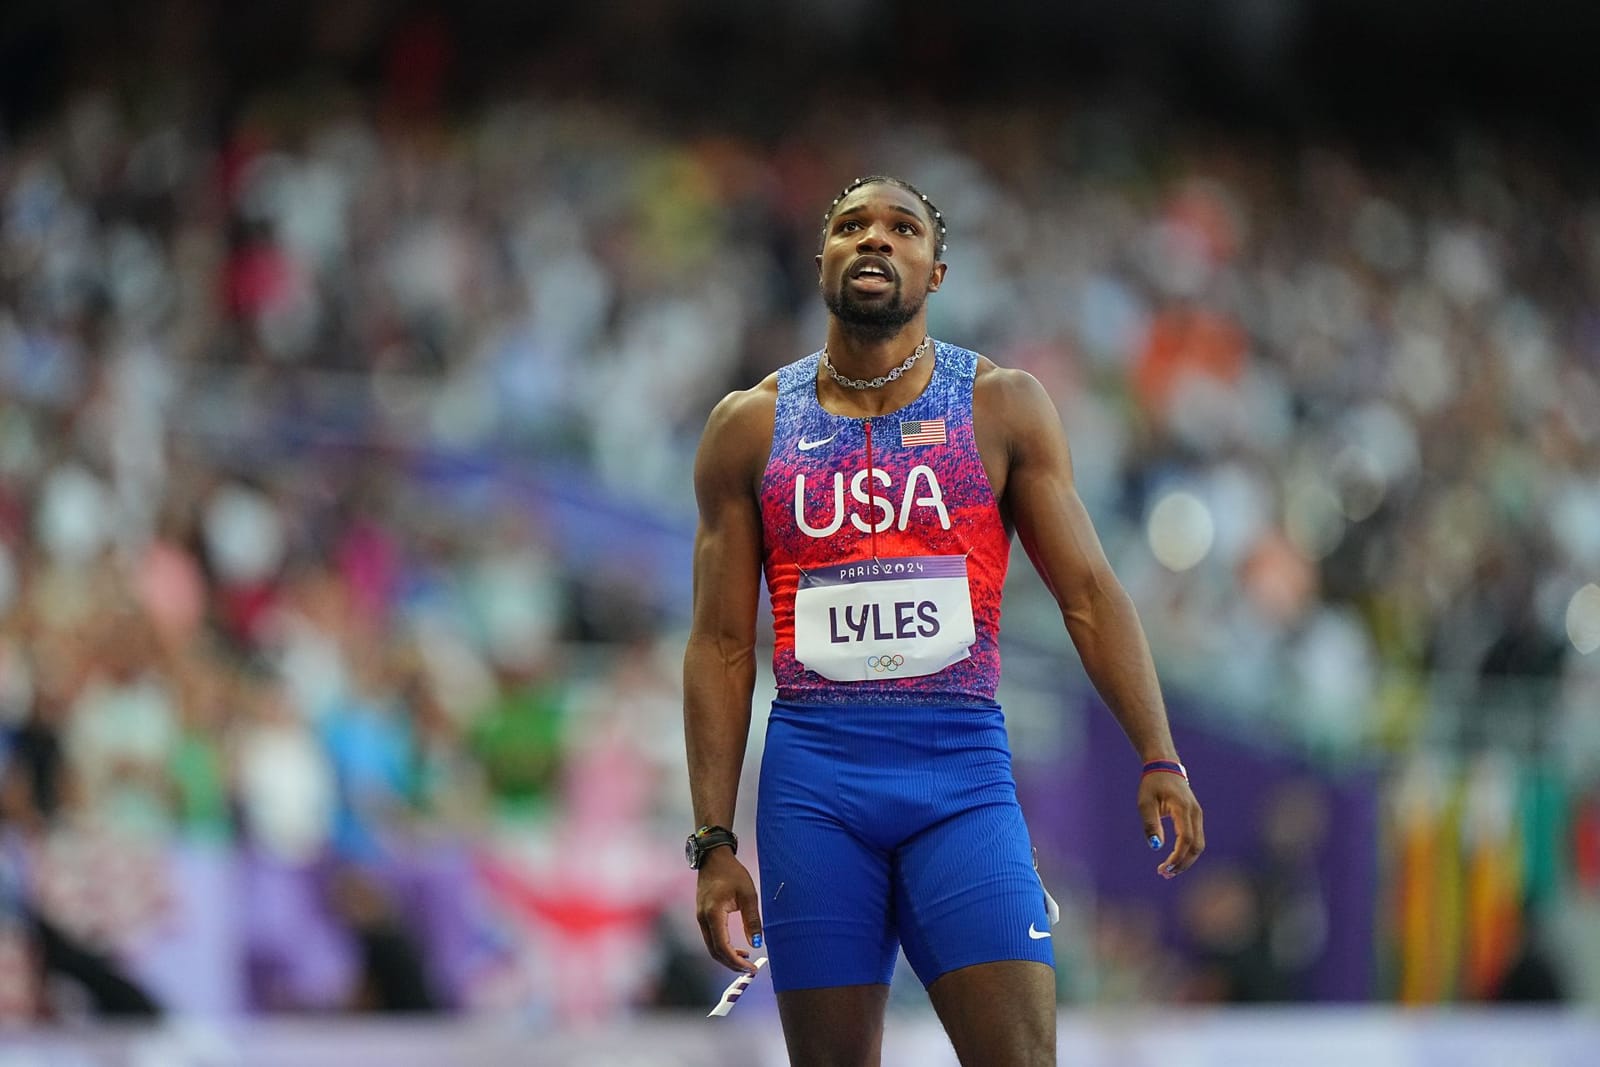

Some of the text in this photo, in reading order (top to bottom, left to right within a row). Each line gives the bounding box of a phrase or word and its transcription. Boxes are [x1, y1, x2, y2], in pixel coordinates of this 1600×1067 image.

[794, 465, 951, 538] USA
[840, 562, 924, 580] PARIS 2024
[829, 600, 941, 644] LYLES
